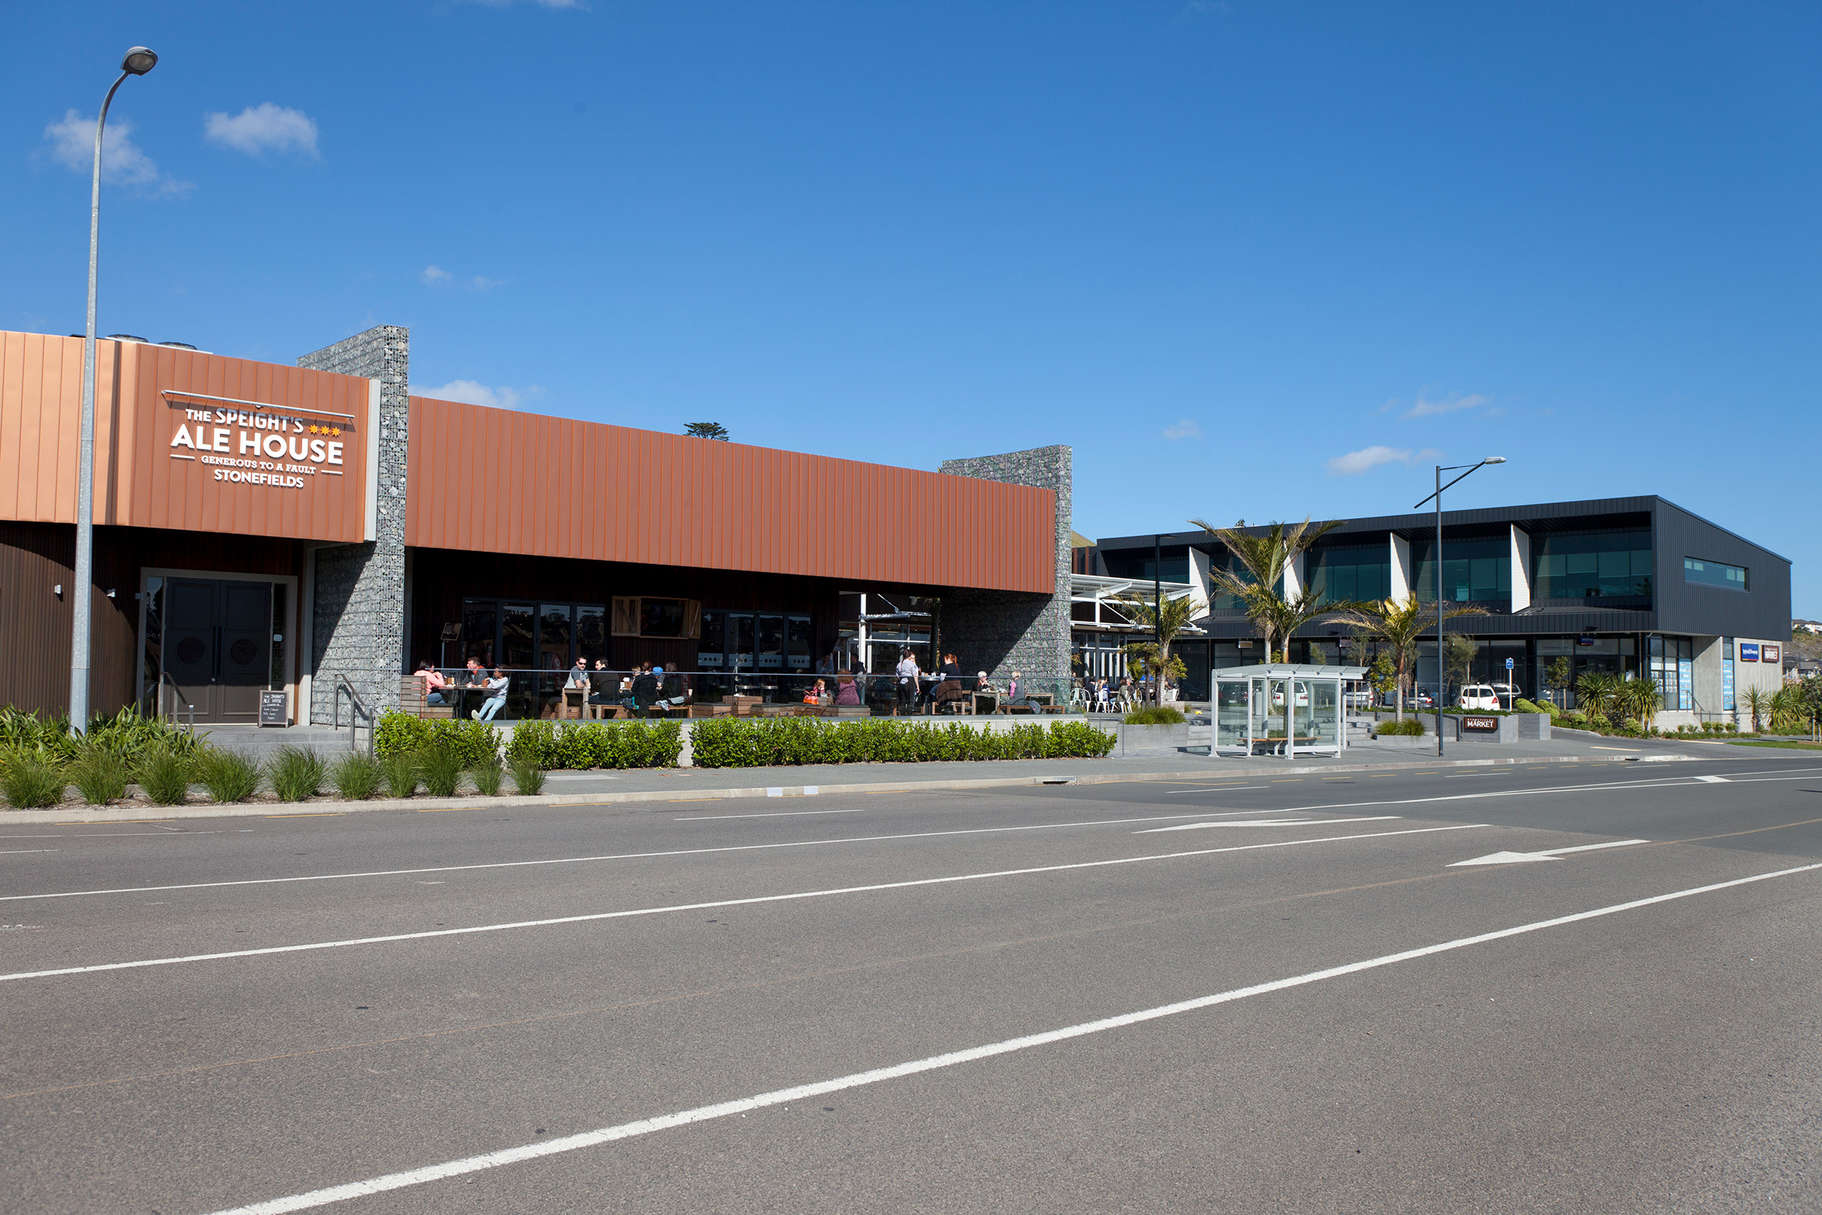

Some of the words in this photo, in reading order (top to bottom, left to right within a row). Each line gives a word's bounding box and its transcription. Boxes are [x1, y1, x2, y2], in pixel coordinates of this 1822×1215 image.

[185, 408, 212, 422] THE
[215, 407, 304, 434] SPEIGHT'S
[170, 423, 231, 452] ALE
[239, 431, 344, 465] HOUSE
[201, 455, 257, 469] GENEROUS
[259, 461, 274, 471] TO
[276, 463, 284, 472] A
[286, 464, 317, 475] FAULT
[214, 469, 304, 488] STONEFIELDS
